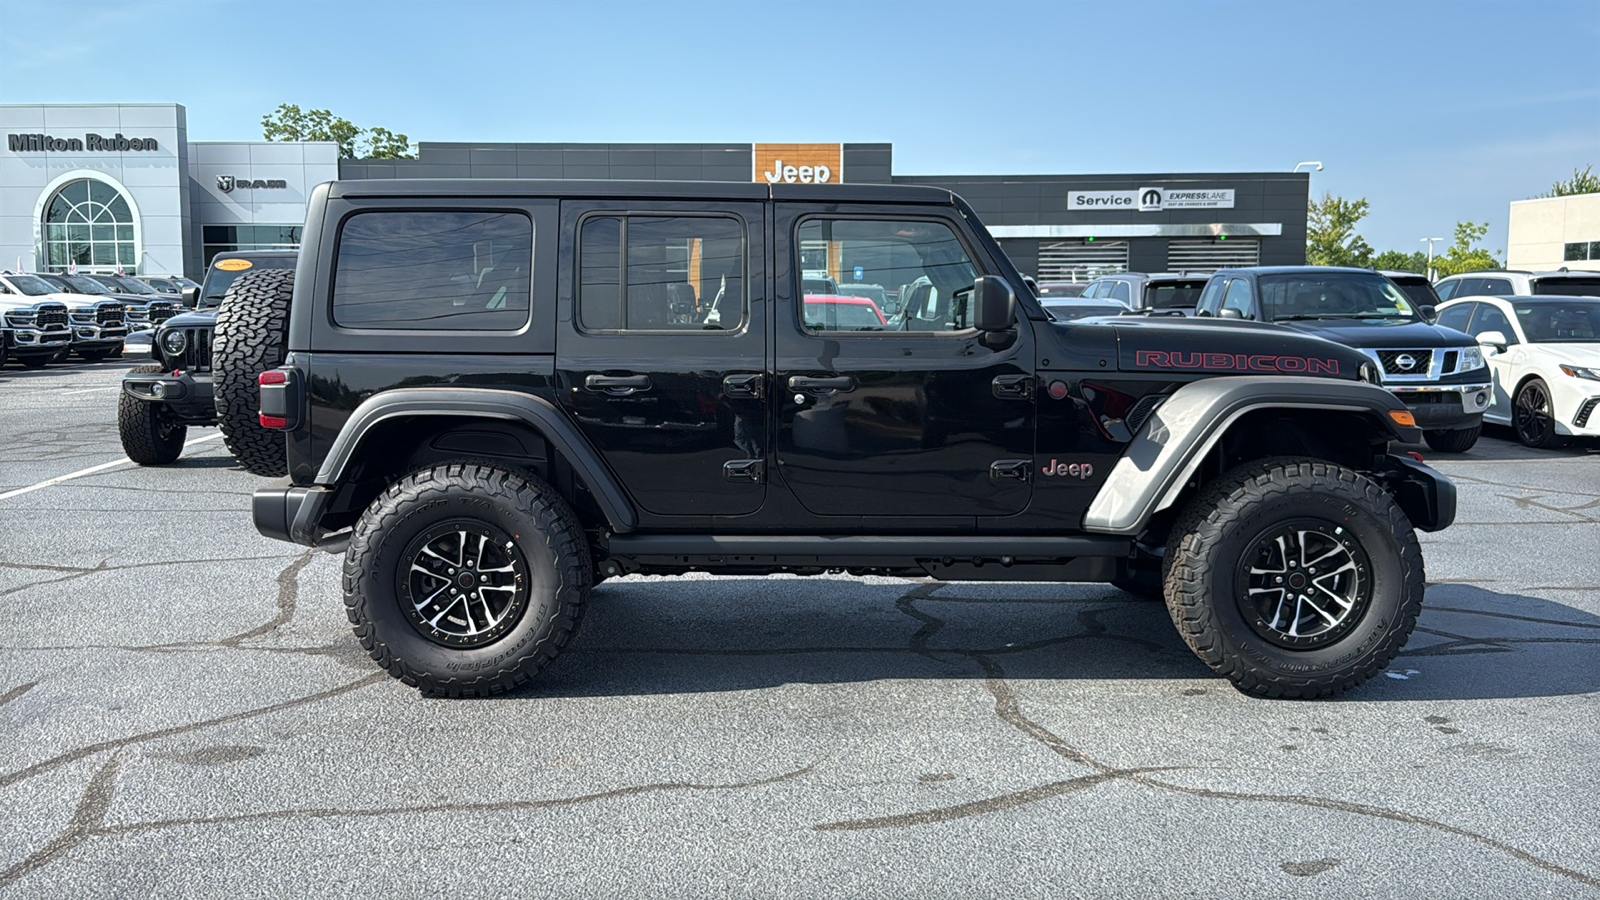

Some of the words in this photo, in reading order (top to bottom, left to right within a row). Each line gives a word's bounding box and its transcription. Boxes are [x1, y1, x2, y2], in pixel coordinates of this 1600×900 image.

[8, 134, 83, 152] Milton
[85, 133, 158, 151] Ruben
[764, 160, 830, 183] Jeep
[236, 179, 287, 189] RAM
[1076, 195, 1132, 206] Service
[1136, 350, 1340, 374] RUBICON
[1042, 459, 1093, 479] Jeep
